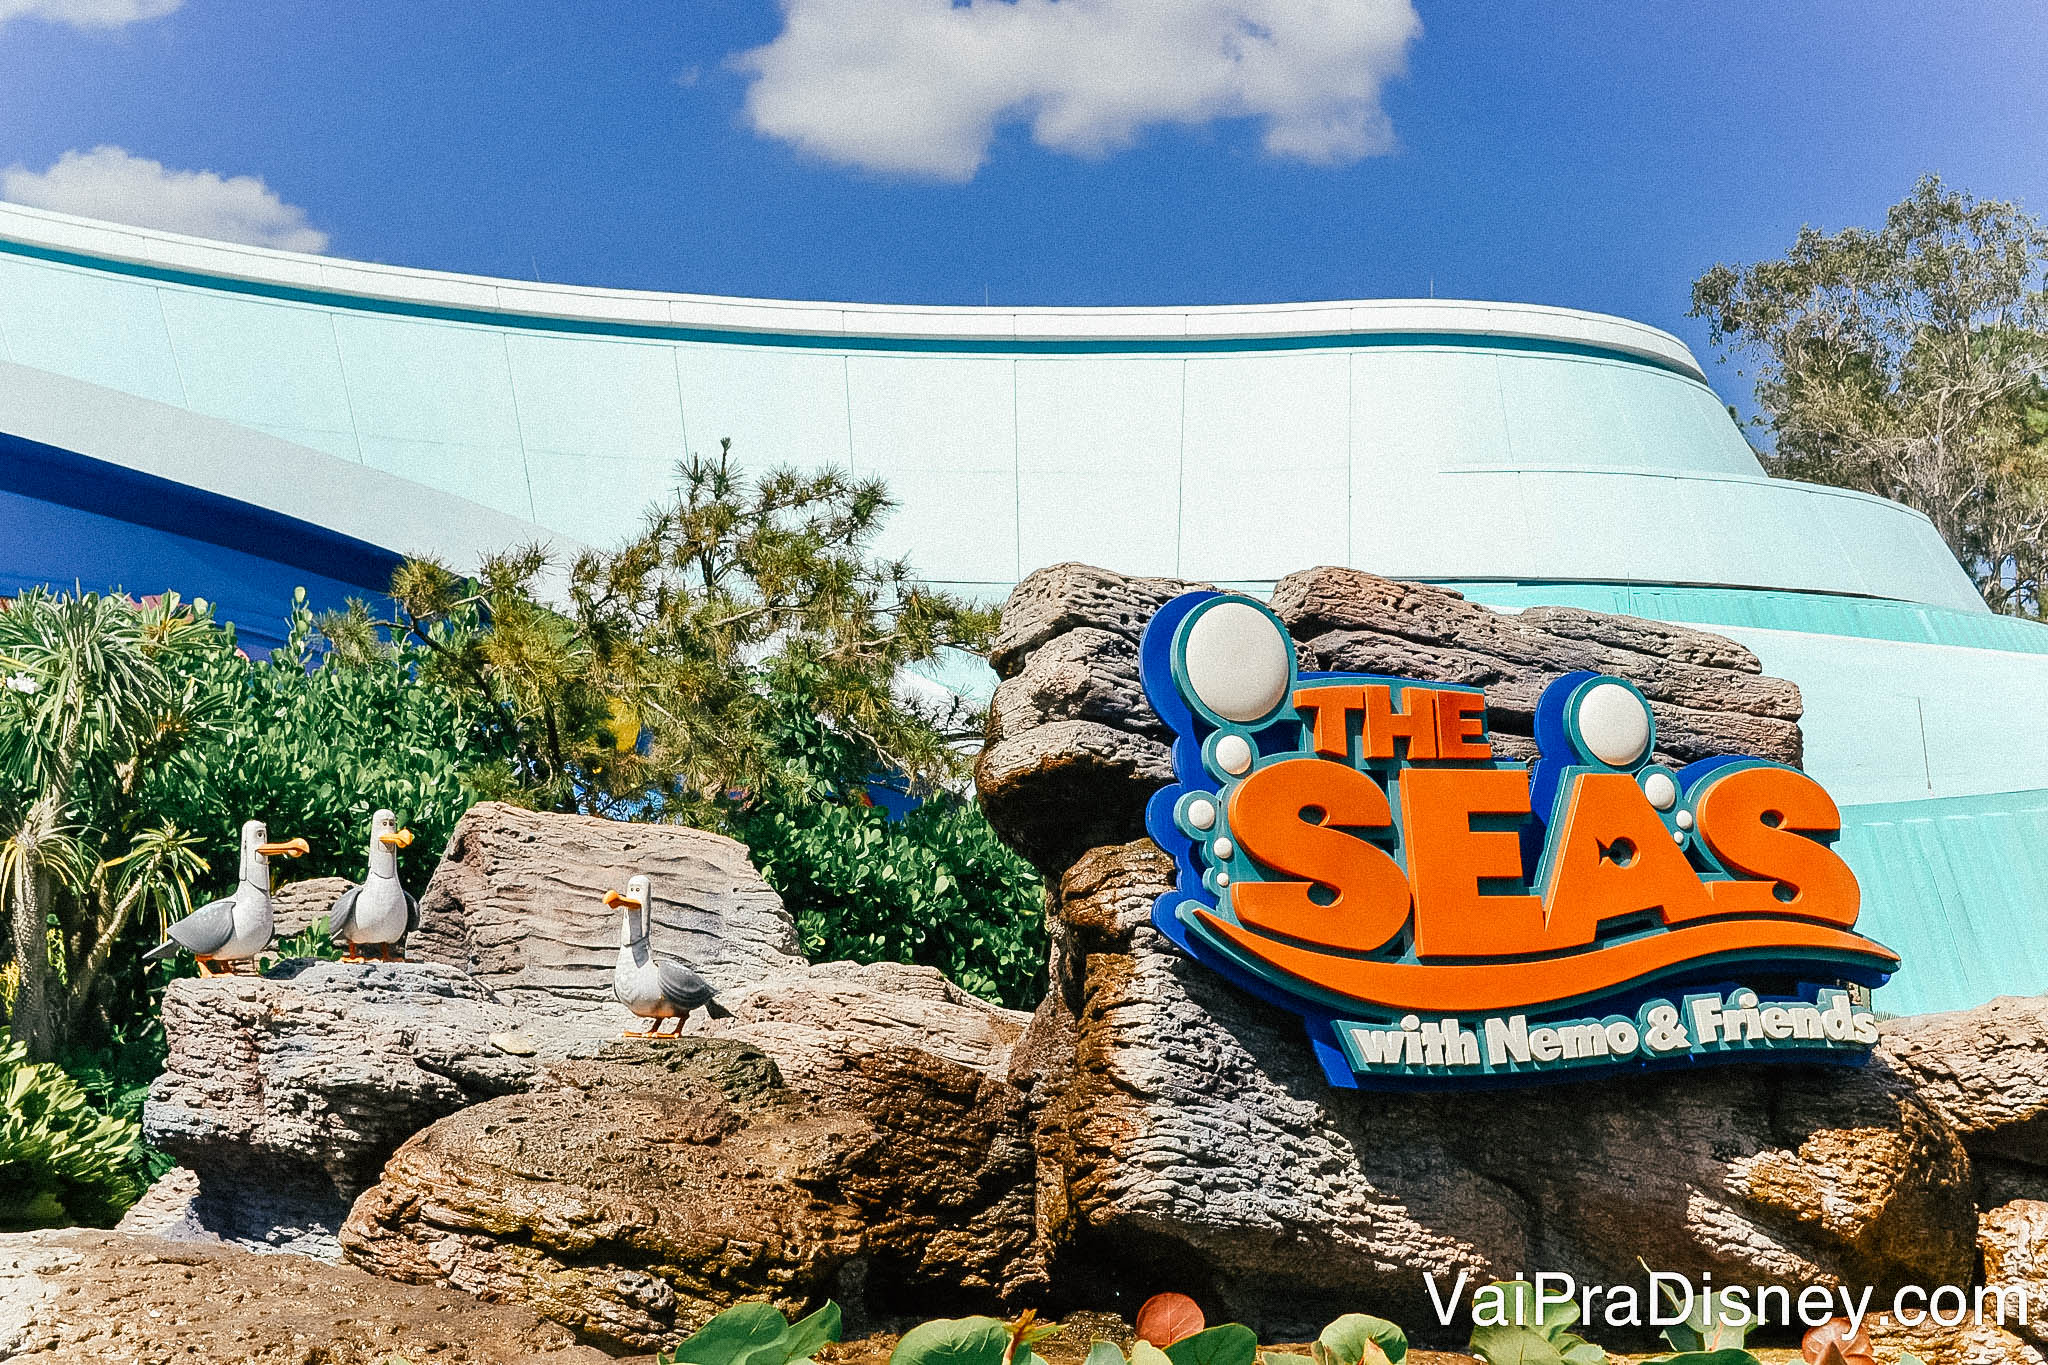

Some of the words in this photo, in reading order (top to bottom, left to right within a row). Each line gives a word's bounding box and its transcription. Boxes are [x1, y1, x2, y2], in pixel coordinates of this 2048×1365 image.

[1293, 684, 1492, 760] THE
[1228, 757, 1861, 958] SEAS
[1349, 1015, 1479, 1065] with
[1486, 1015, 1638, 1066] Nemo
[1645, 1005, 1691, 1052] &
[1690, 991, 1879, 1044] Friends
